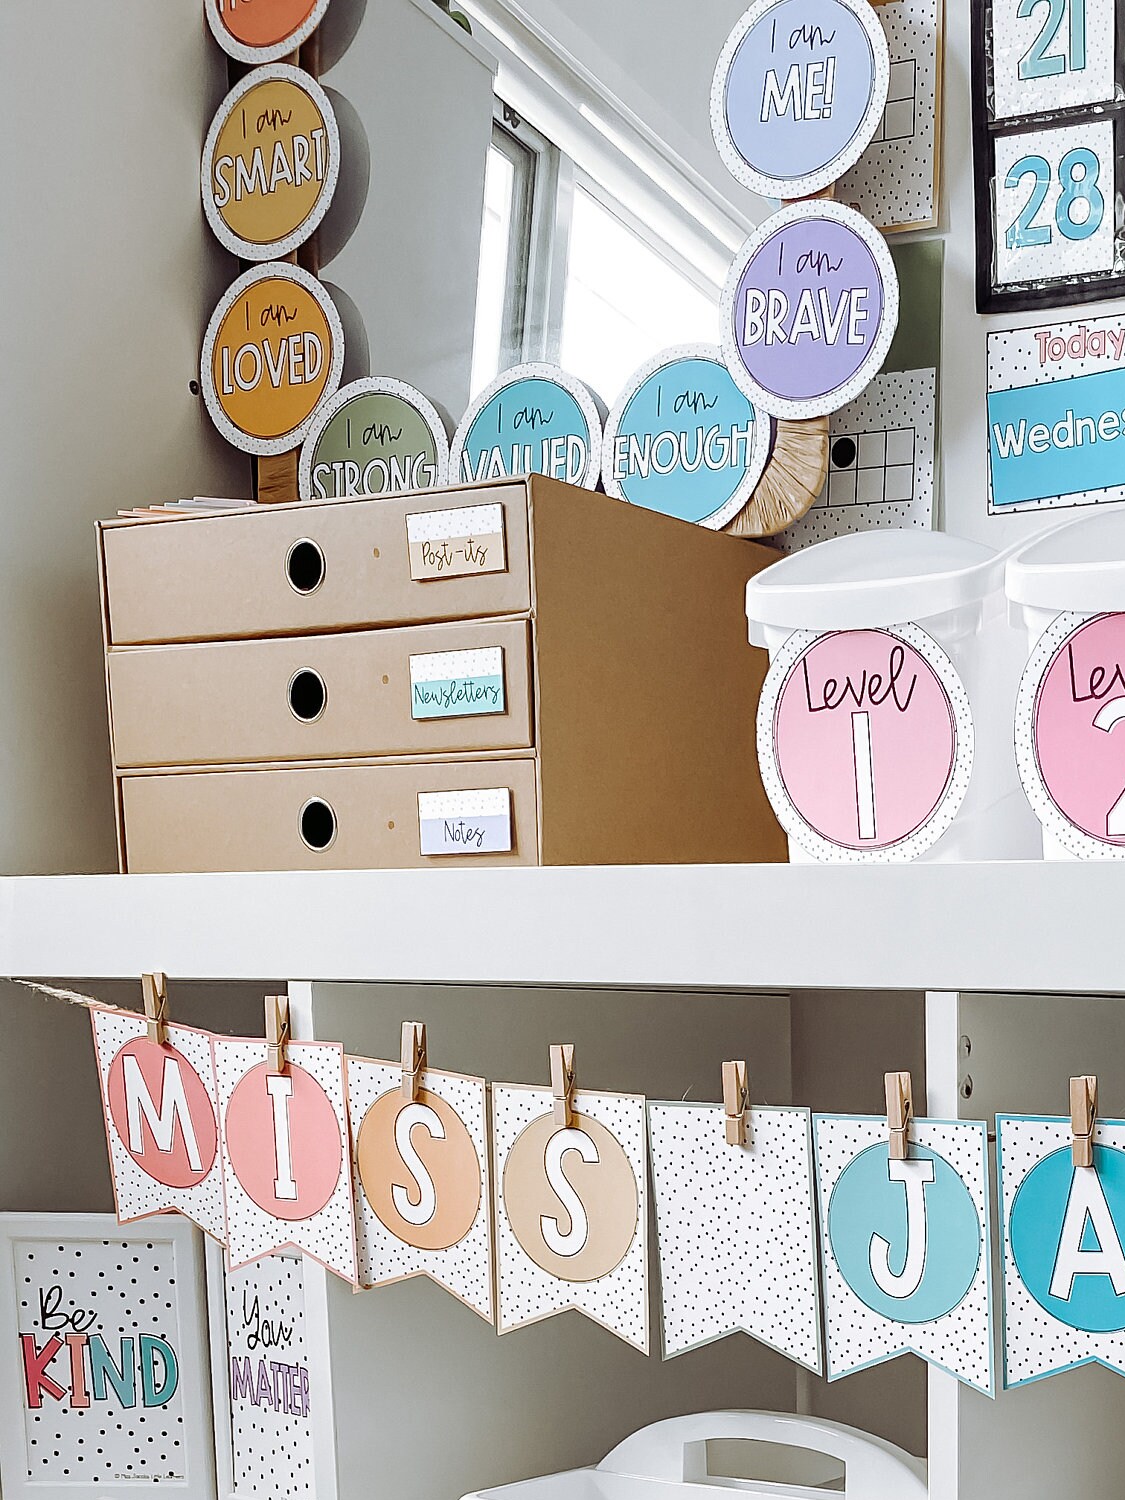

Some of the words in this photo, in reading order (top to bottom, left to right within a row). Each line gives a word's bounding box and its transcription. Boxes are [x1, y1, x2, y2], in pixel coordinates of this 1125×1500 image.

[771, 18, 777, 53] I
[788, 23, 837, 51] am
[1016, 0, 1087, 81] 21
[759, 56, 837, 123] ME!
[241, 108, 247, 140] I
[256, 108, 293, 134] am
[212, 126, 325, 209] SMART
[1003, 147, 1105, 249] 28
[777, 241, 784, 276] I
[795, 249, 844, 276] am
[245, 301, 250, 331] I
[260, 303, 298, 327] am
[741, 285, 870, 347] BRAVE
[1034, 322, 1125, 365] Today
[220, 331, 324, 395] LOVED
[496, 401, 502, 434] I
[512, 403, 554, 432] am
[656, 384, 662, 417] I
[672, 385, 717, 415] am
[345, 417, 352, 450] I
[362, 419, 403, 448] am
[612, 419, 756, 481] ENOUGH
[310, 449, 439, 500] STRONG
[420, 541, 489, 569] Post-its
[413, 678, 502, 709] Newsletters
[802, 645, 918, 713] Level
[850, 710, 877, 840] 1
[442, 819, 488, 848] Notes
[123, 1055, 600, 1257] MISS
[39, 1285, 98, 1333] Be
[242, 1289, 294, 1351] You
[19, 1331, 179, 1410] KIND
[232, 1355, 310, 1418] MATTER
